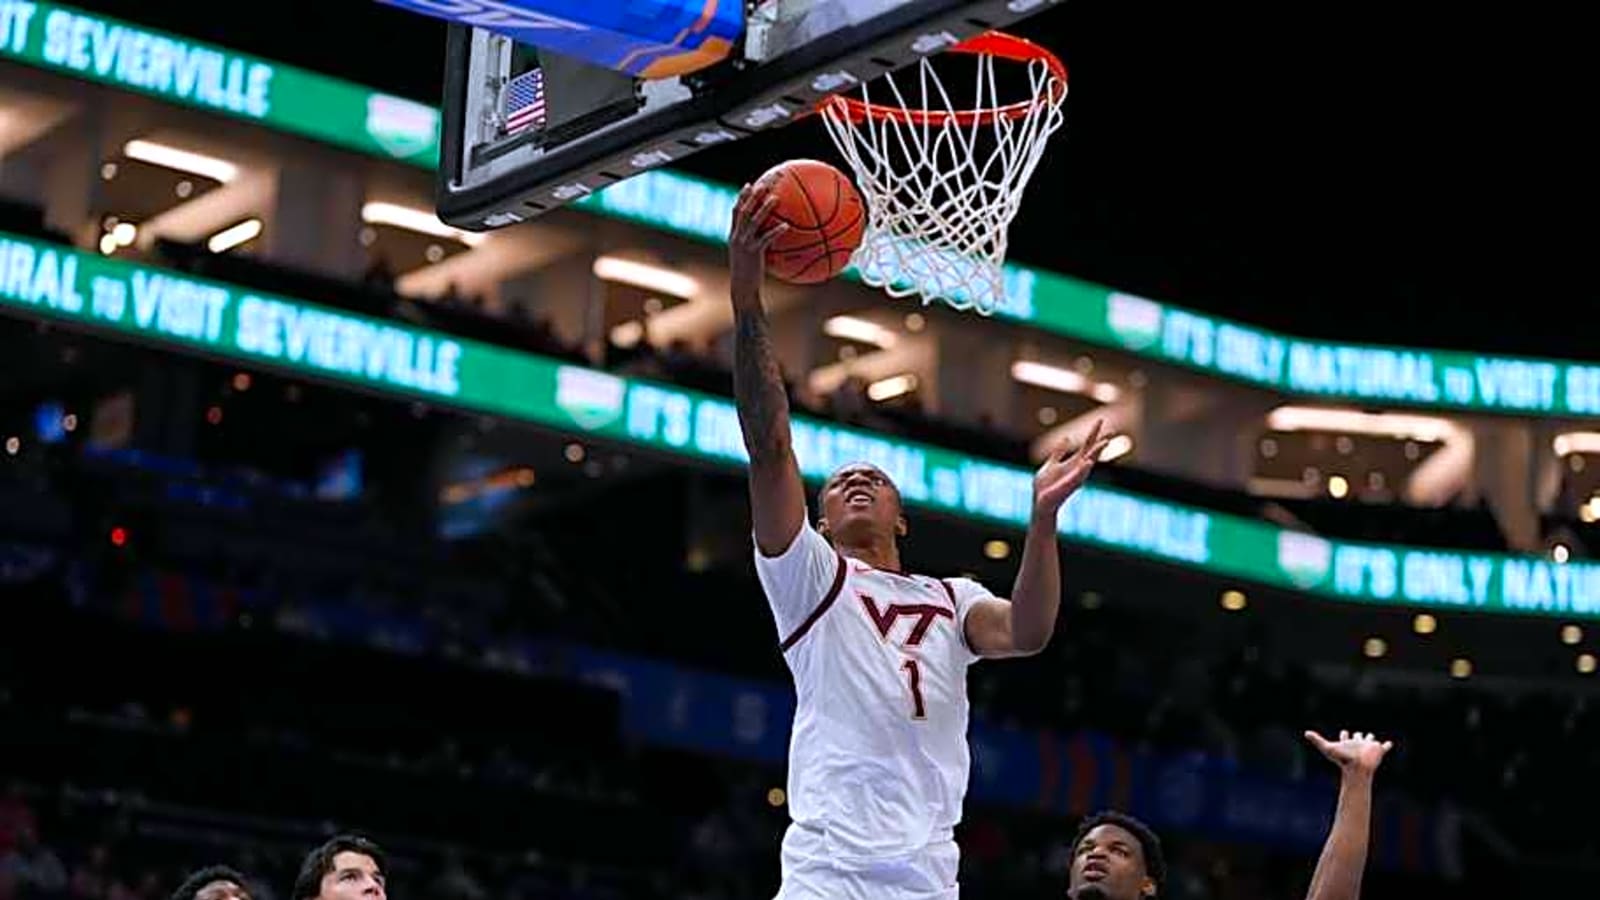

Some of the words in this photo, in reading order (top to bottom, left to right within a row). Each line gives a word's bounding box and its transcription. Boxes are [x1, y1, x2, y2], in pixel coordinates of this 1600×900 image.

[43, 8, 274, 117] SEVIERVILLE
[131, 270, 229, 341] VISIT
[237, 295, 462, 396] SEVIERVILLE
[1162, 309, 1213, 366] IT'S
[1215, 323, 1285, 385] ONLY
[1288, 341, 1438, 401] NATURAL
[1475, 357, 1557, 411] VISIT
[626, 382, 690, 447] IT'S
[1334, 545, 1397, 599] IT'S
[1403, 551, 1492, 605] ONLY
[857, 591, 953, 646] VT
[901, 658, 927, 721] 1
